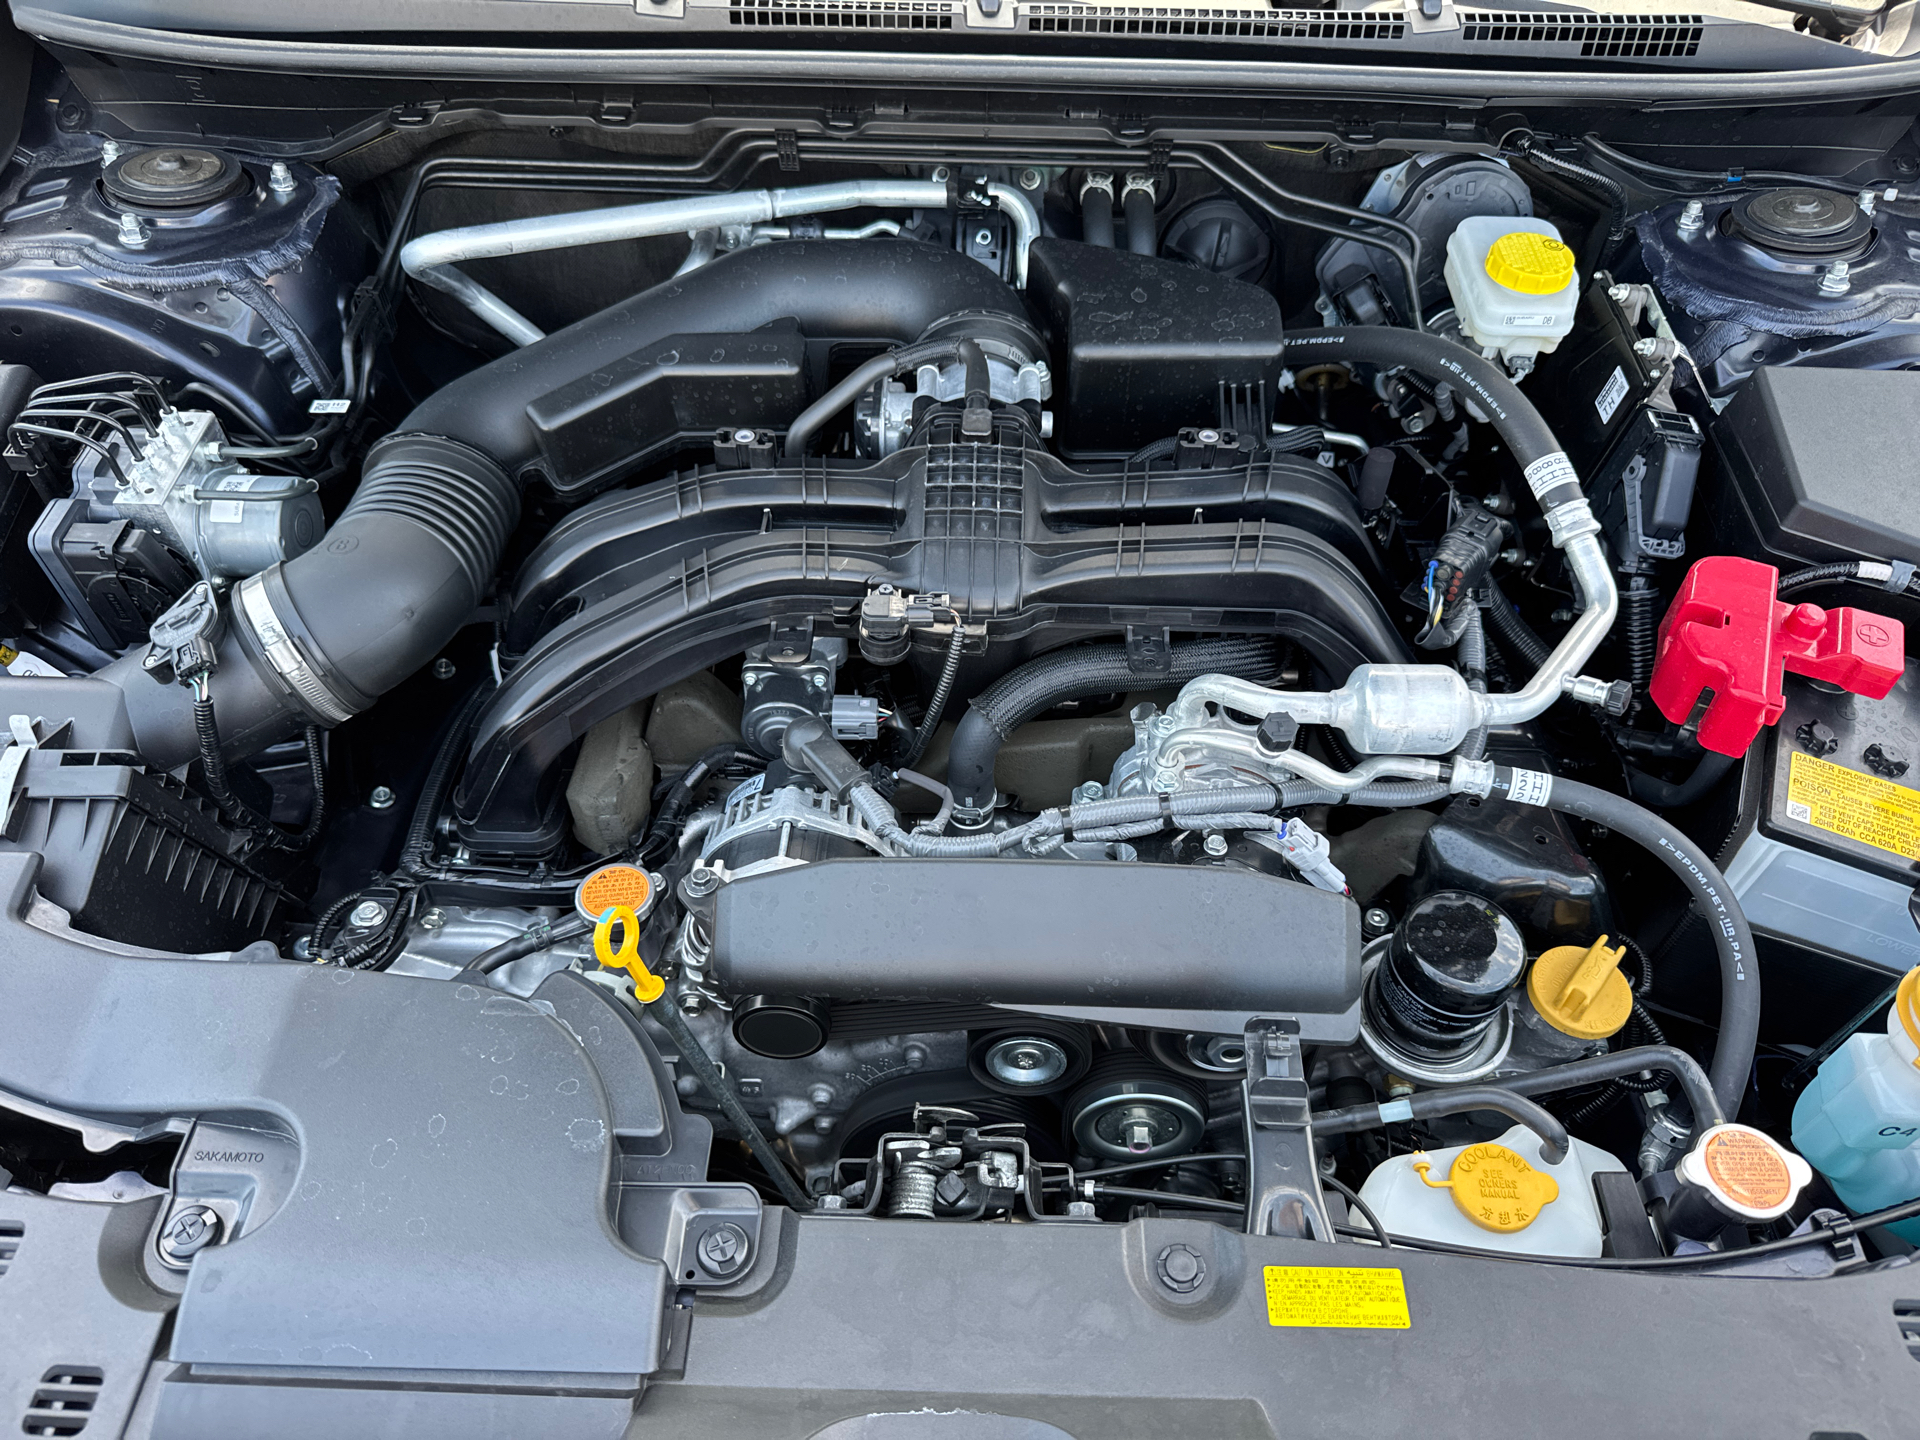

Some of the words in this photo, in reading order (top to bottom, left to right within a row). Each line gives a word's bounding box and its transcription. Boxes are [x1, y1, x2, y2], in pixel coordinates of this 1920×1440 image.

[1795, 753, 1835, 772] DANGER
[1837, 767, 1872, 784] EXPLOSIVE
[1873, 779, 1896, 792] GASES
[1792, 777, 1831, 796] POISON
[1836, 792, 1862, 806] CAUSES
[1864, 801, 1890, 815] SEVERE
[1891, 810, 1914, 824] BURNS
[1818, 810, 1836, 821] KEEP
[1837, 816, 1852, 826] OUT
[1852, 821, 1861, 830] OF
[1862, 824, 1886, 838] REACH
[1886, 832, 1896, 841] OF
[1819, 803, 1837, 815] KEEP
[1837, 809, 1855, 821] VENT
[1856, 815, 1874, 827] CAPS
[1875, 822, 1895, 834] TIGHT
[1895, 828, 1910, 840] AND
[1814, 815, 1835, 830] 20HR
[1835, 823, 1856, 837] 62Ah
[1858, 830, 1877, 844] CCA
[1877, 836, 1897, 851] 620A
[1878, 1126, 1917, 1137] C4
[194, 1151, 264, 1163] SAKAMOTO
[1458, 1146, 1531, 1173] COOLANT
[1478, 1178, 1518, 1189] OWNERS
[1483, 1169, 1503, 1179] SEE
[1480, 1189, 1520, 1199] MANUAL
[1290, 1268, 1313, 1276] CAUTION
[1315, 1268, 1344, 1276] ATTENTION
